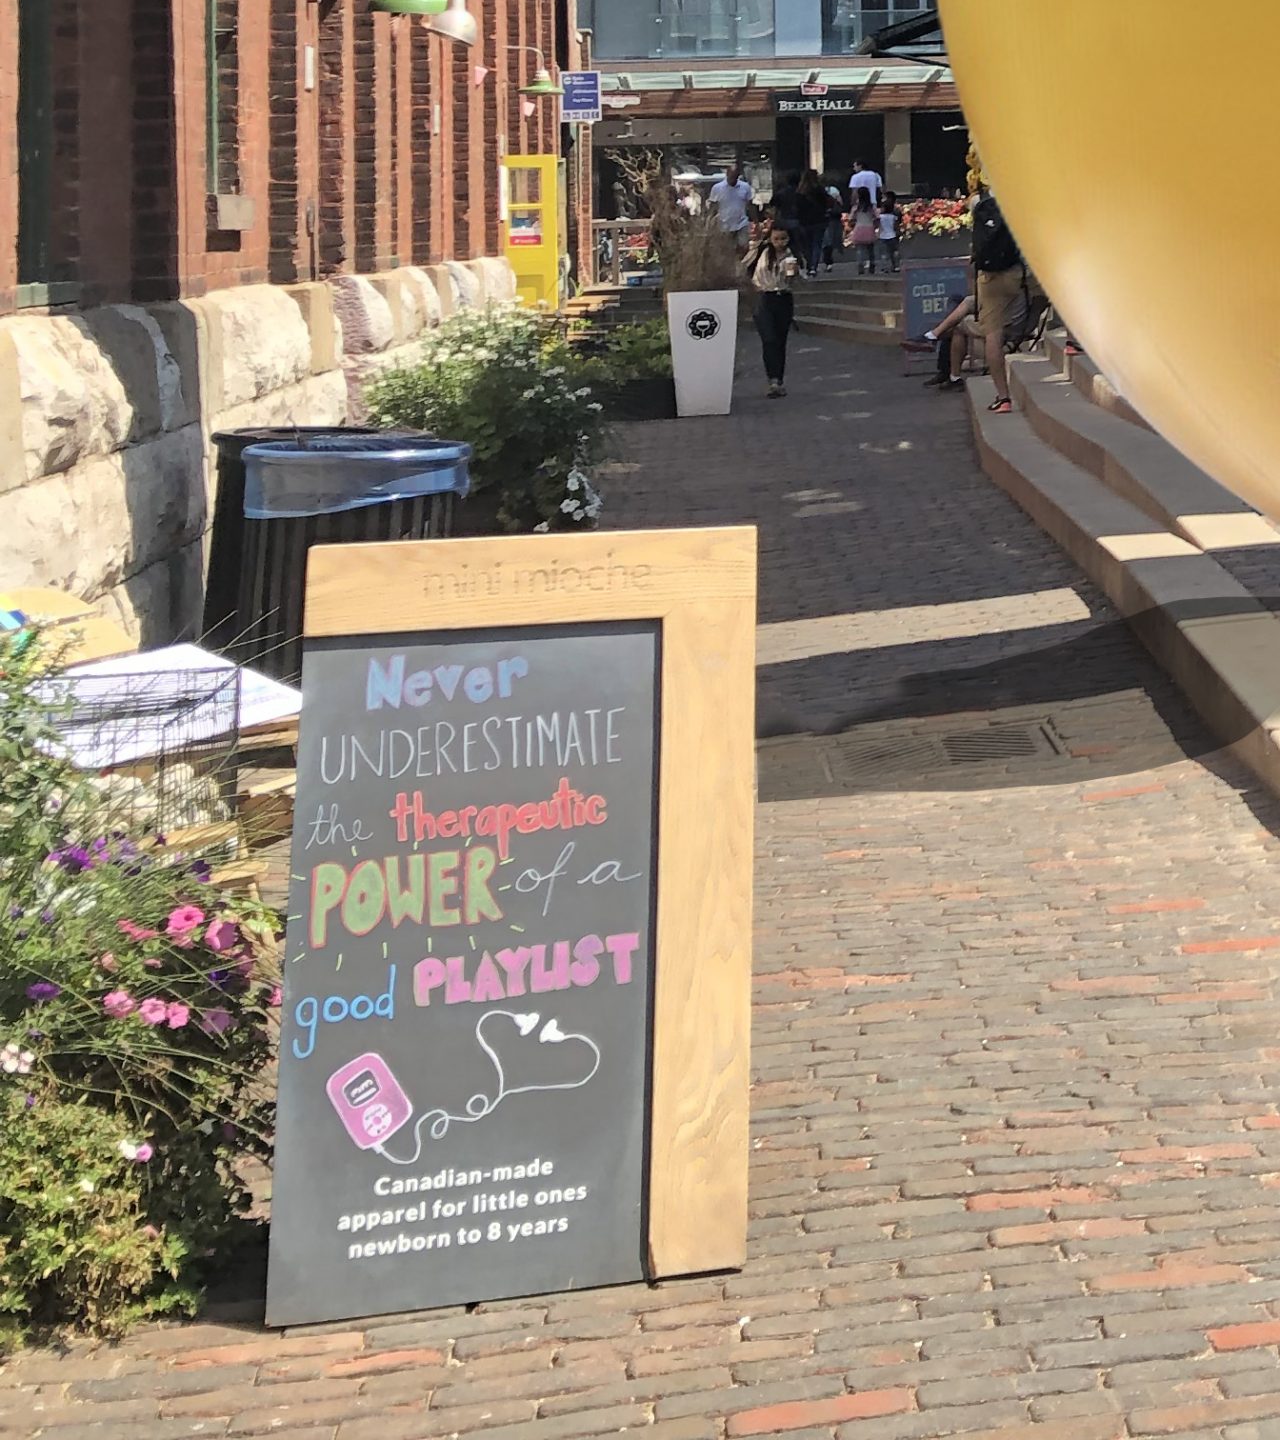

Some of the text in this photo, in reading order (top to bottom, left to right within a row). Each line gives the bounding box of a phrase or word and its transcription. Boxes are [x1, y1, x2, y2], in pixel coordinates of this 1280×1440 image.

[778, 99, 855, 111] BEER HALL
[912, 283, 945, 297] COLD
[423, 550, 651, 599] mini mioche
[366, 654, 528, 711] Never
[320, 707, 626, 784] UNDERESTIMATE
[305, 776, 608, 862] the therapeutic
[309, 841, 642, 949] POWER of a
[293, 932, 640, 1058] good PLAYLIST
[373, 1158, 554, 1197] Canadian-made
[337, 1185, 588, 1233] apparel for little ones
[347, 1215, 569, 1260] newborn to 8 years
